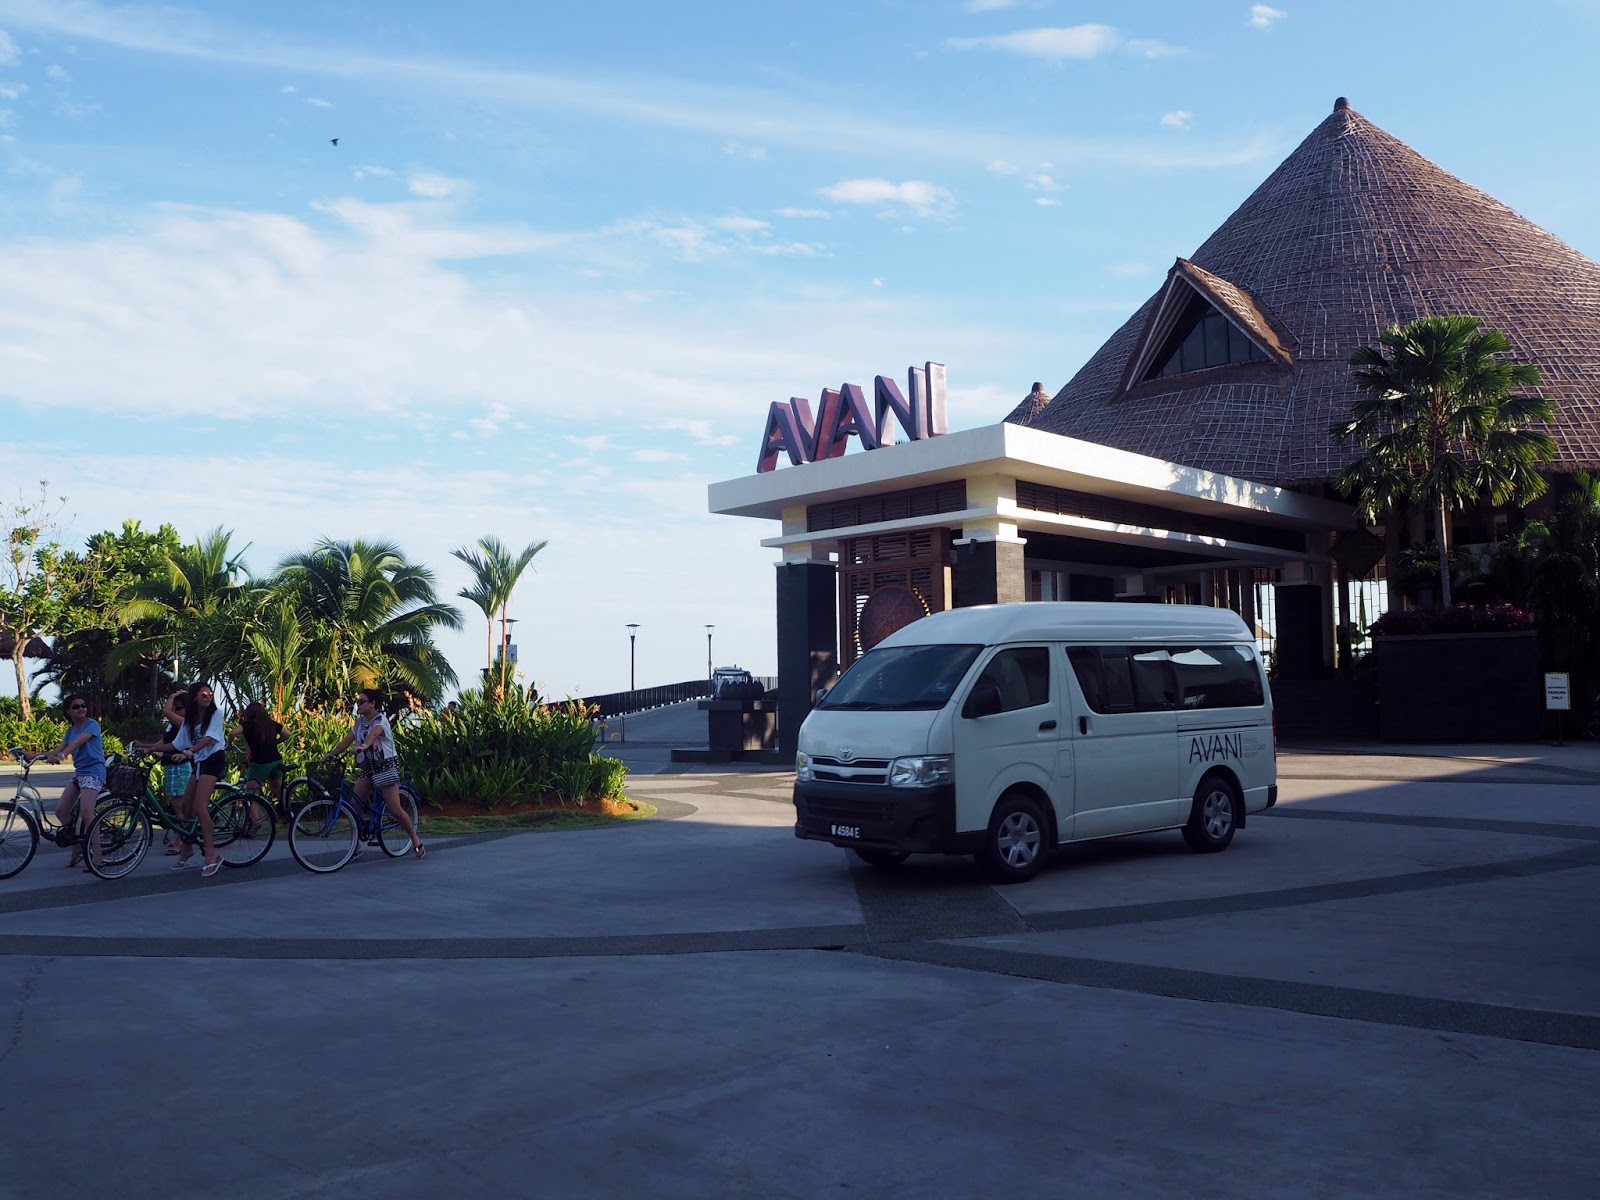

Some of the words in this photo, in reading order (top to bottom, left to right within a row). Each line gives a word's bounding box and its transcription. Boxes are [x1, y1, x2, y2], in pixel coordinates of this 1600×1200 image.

[757, 361, 947, 473] AVANI
[1188, 733, 1243, 764] AVANI
[831, 824, 861, 839] 4584E
